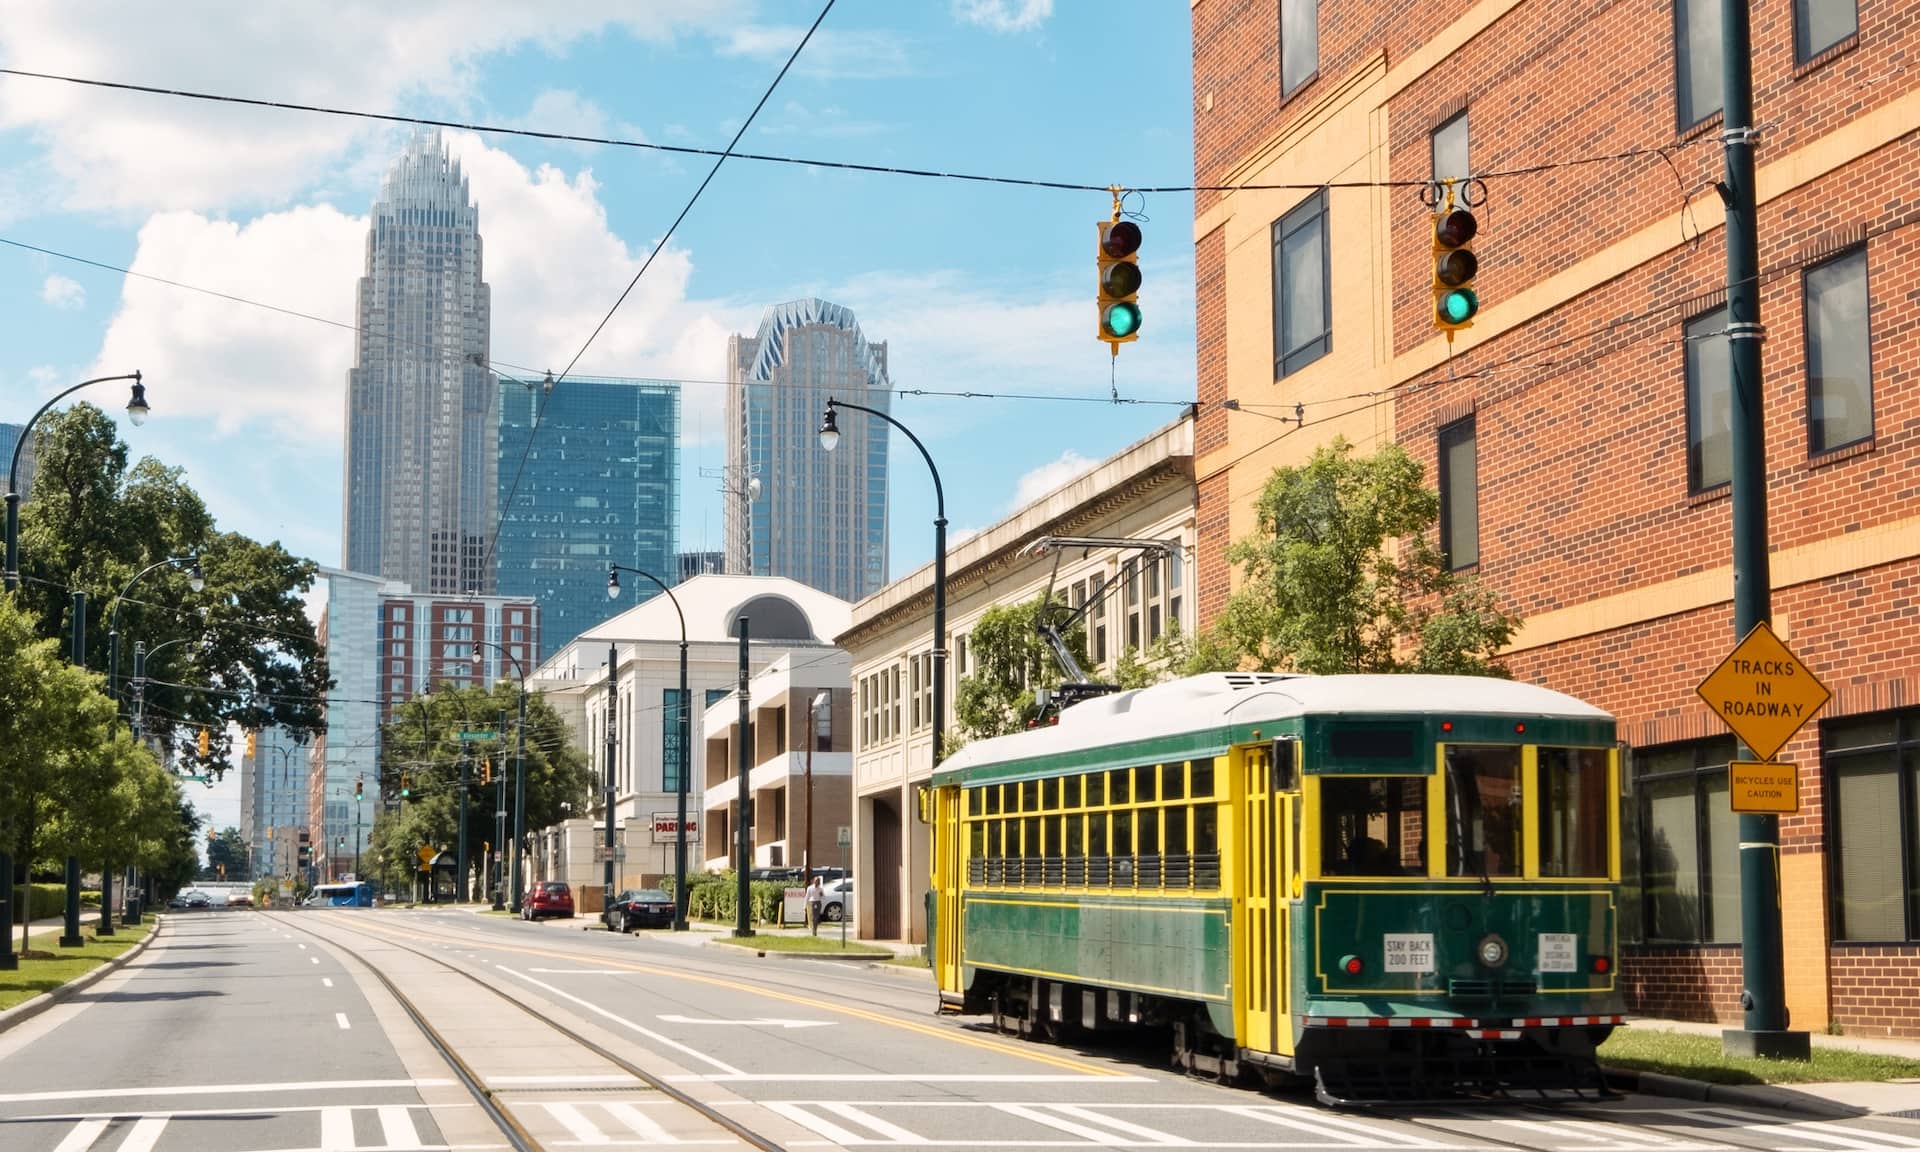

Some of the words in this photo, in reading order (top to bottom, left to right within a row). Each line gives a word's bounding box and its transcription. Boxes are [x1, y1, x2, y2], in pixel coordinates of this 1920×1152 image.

[1733, 660, 1795, 676] TRACKS
[1755, 681, 1771, 696] IN
[1723, 701, 1804, 717] ROADWAY
[1735, 776, 1775, 785] BICYCLES
[1777, 777, 1793, 786] USE
[1747, 790, 1782, 799] CAUTION
[655, 822, 697, 832] PARNG
[1386, 940, 1406, 952] STAY
[1409, 940, 1431, 952] BACK
[1388, 953, 1407, 965] 200
[1410, 954, 1429, 965] FEET
